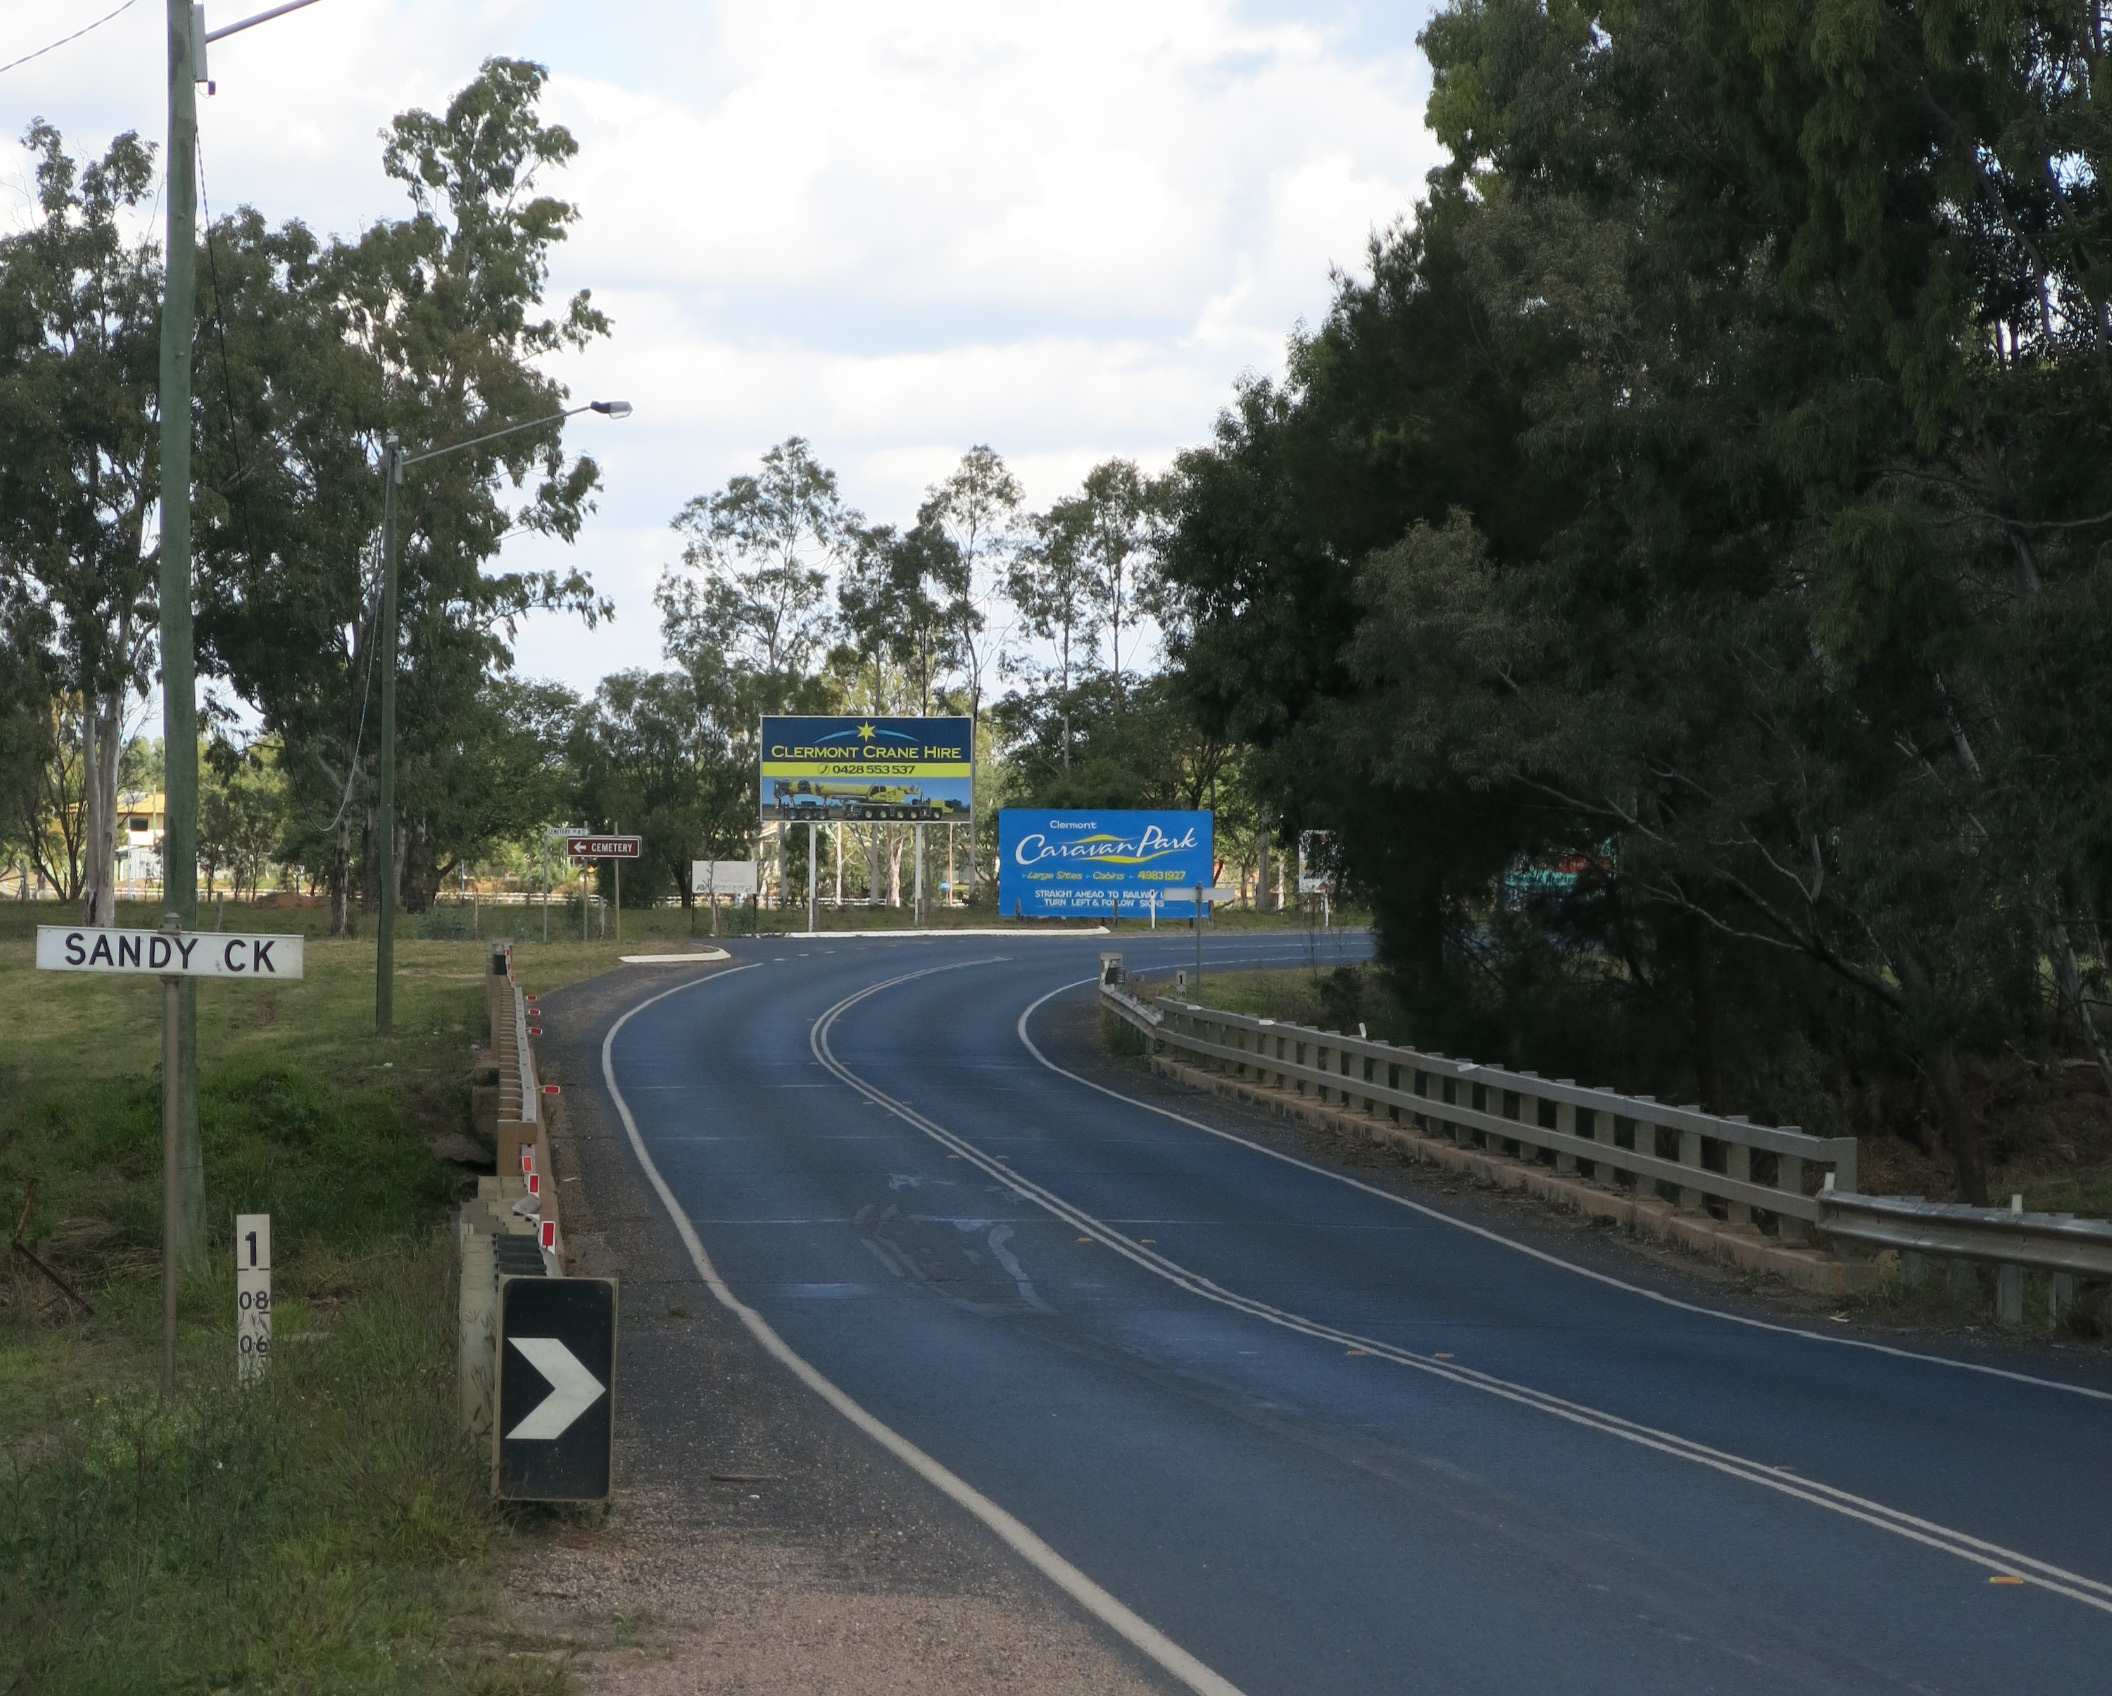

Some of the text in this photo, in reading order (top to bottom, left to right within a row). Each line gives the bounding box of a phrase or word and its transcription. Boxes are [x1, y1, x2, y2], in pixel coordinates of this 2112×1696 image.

[771, 746, 961, 758] CLERMONT CRANE HIRE
[832, 765, 915, 774] 0428 553 537
[1050, 820, 1096, 829] Clermont
[591, 843, 632, 853] CEMETERY
[1015, 826, 1198, 865] Caravan Park
[1035, 890, 1072, 898] STRAIGHT
[1075, 890, 1104, 898] AHEAD
[1109, 890, 1119, 898] TO
[1044, 898, 1066, 906] TURN
[65, 932, 275, 973] SANDY CK
[245, 1231, 257, 1267] 1
